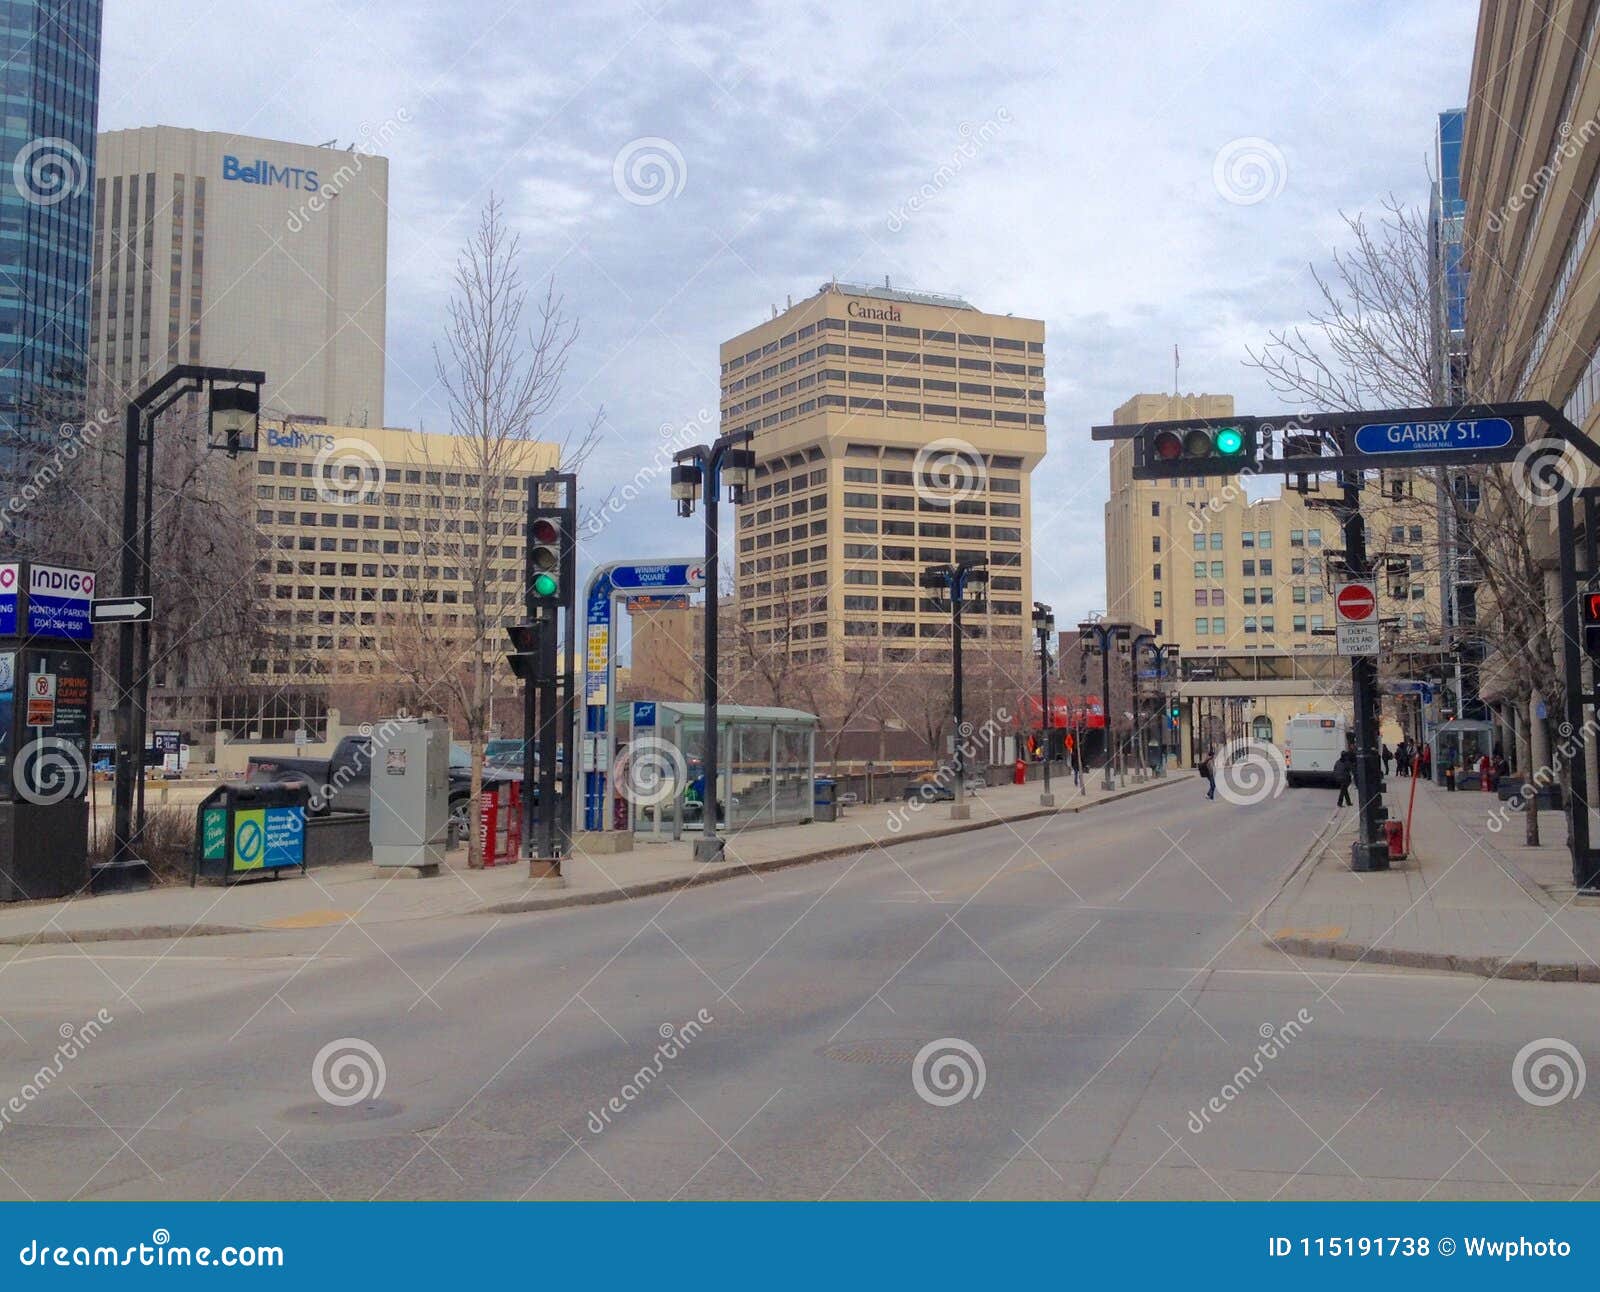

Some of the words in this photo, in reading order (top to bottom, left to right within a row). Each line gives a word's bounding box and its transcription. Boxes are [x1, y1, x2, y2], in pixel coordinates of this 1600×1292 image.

[847, 301, 901, 322] Canada
[1387, 422, 1451, 443] GARRY
[1457, 421, 1481, 441] ST.
[634, 566, 669, 574] WINNIPEG
[638, 573, 666, 582] SQUARE
[32, 569, 94, 594] INDIGO
[28, 604, 61, 615] MONTHLY
[63, 607, 90, 618] PARKIN
